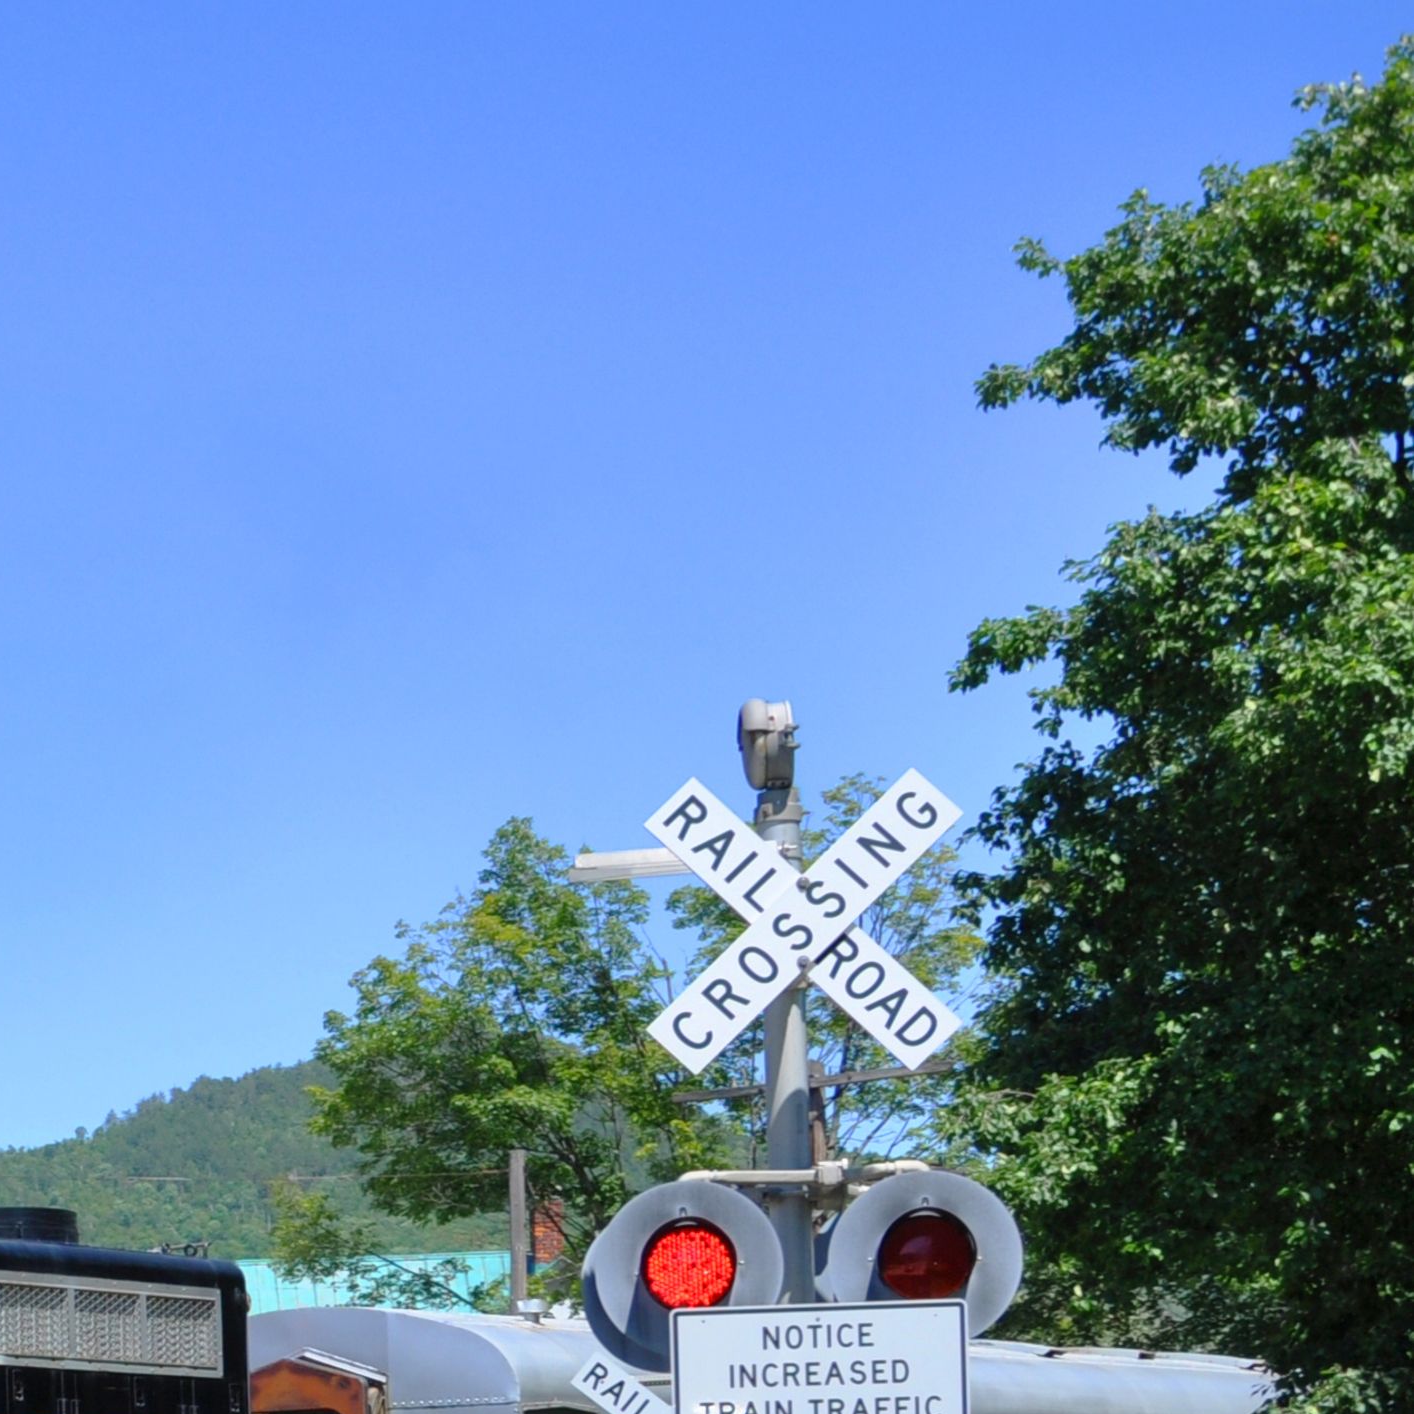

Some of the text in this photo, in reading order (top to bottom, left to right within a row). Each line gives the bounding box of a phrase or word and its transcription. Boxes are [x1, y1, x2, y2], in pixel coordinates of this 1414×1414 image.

[662, 794, 939, 1047] RAIL ROAD
[672, 791, 939, 1050] CROSSING
[729, 1359, 910, 1388] INCREASED
[762, 1323, 875, 1350] NOTICE
